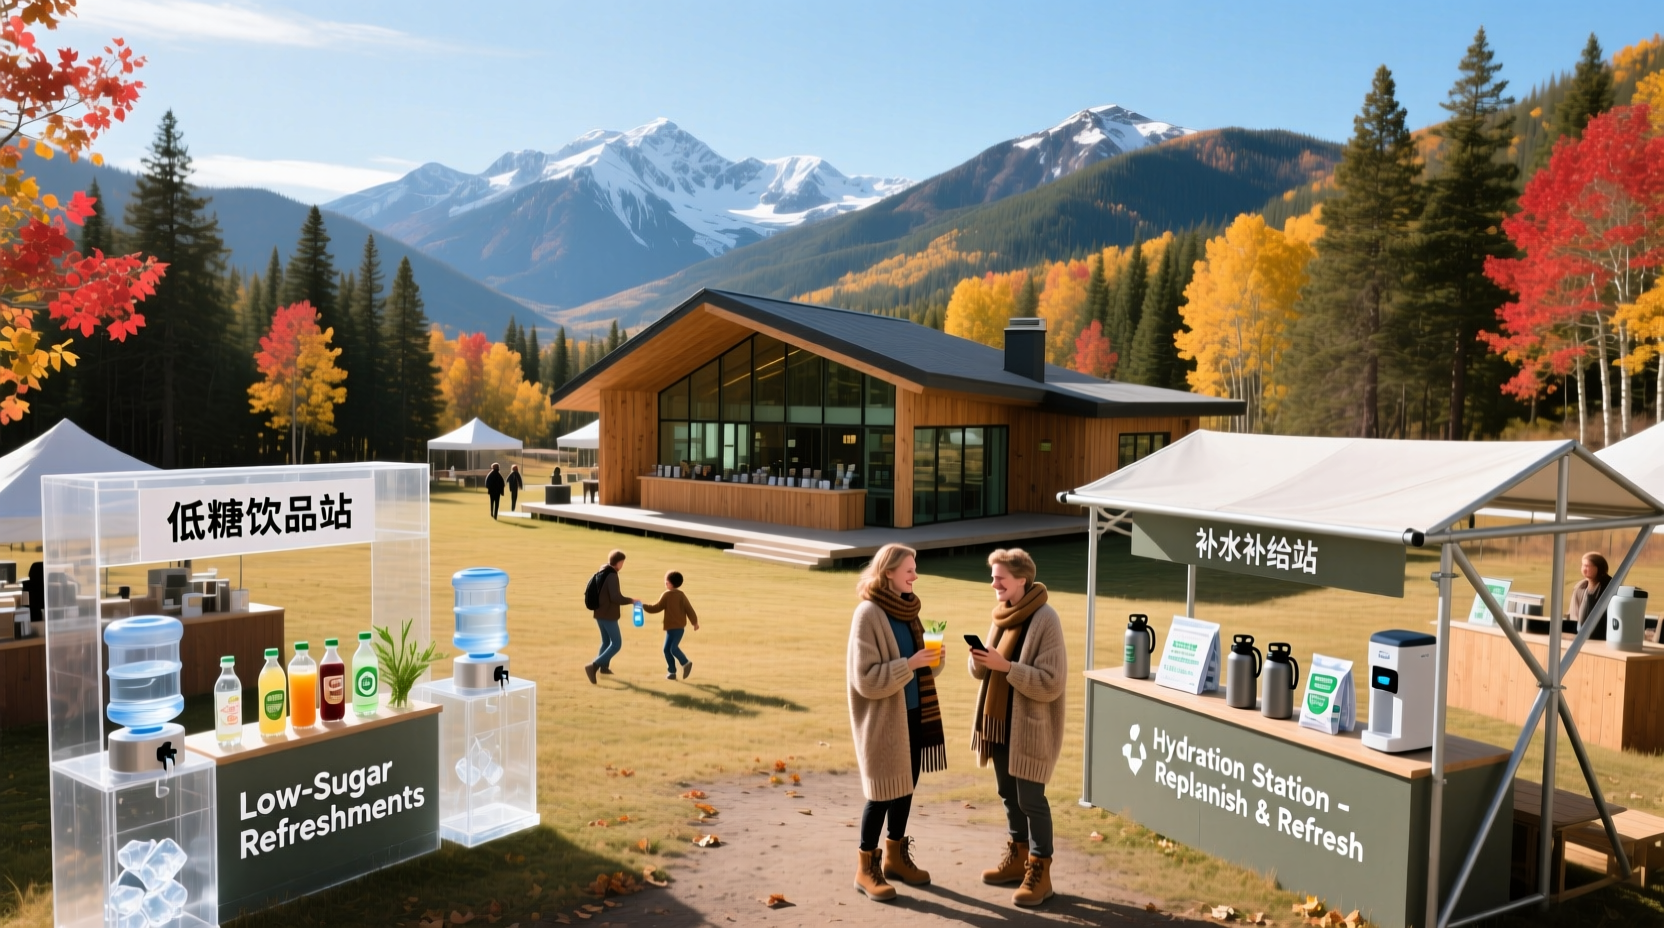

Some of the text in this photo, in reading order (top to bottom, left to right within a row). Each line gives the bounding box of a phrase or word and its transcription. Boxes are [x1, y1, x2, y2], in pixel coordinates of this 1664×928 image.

[167, 492, 353, 543] 低糖饮品站
[1195, 527, 1319, 575] 补水补给站
[240, 760, 393, 821] Low-Sugar
[1153, 727, 1245, 782] Hydration
[1252, 762, 1329, 813] Station
[240, 785, 425, 860] Refreshments
[1255, 798, 1271, 827] &
[1278, 806, 1364, 863] Refresh
